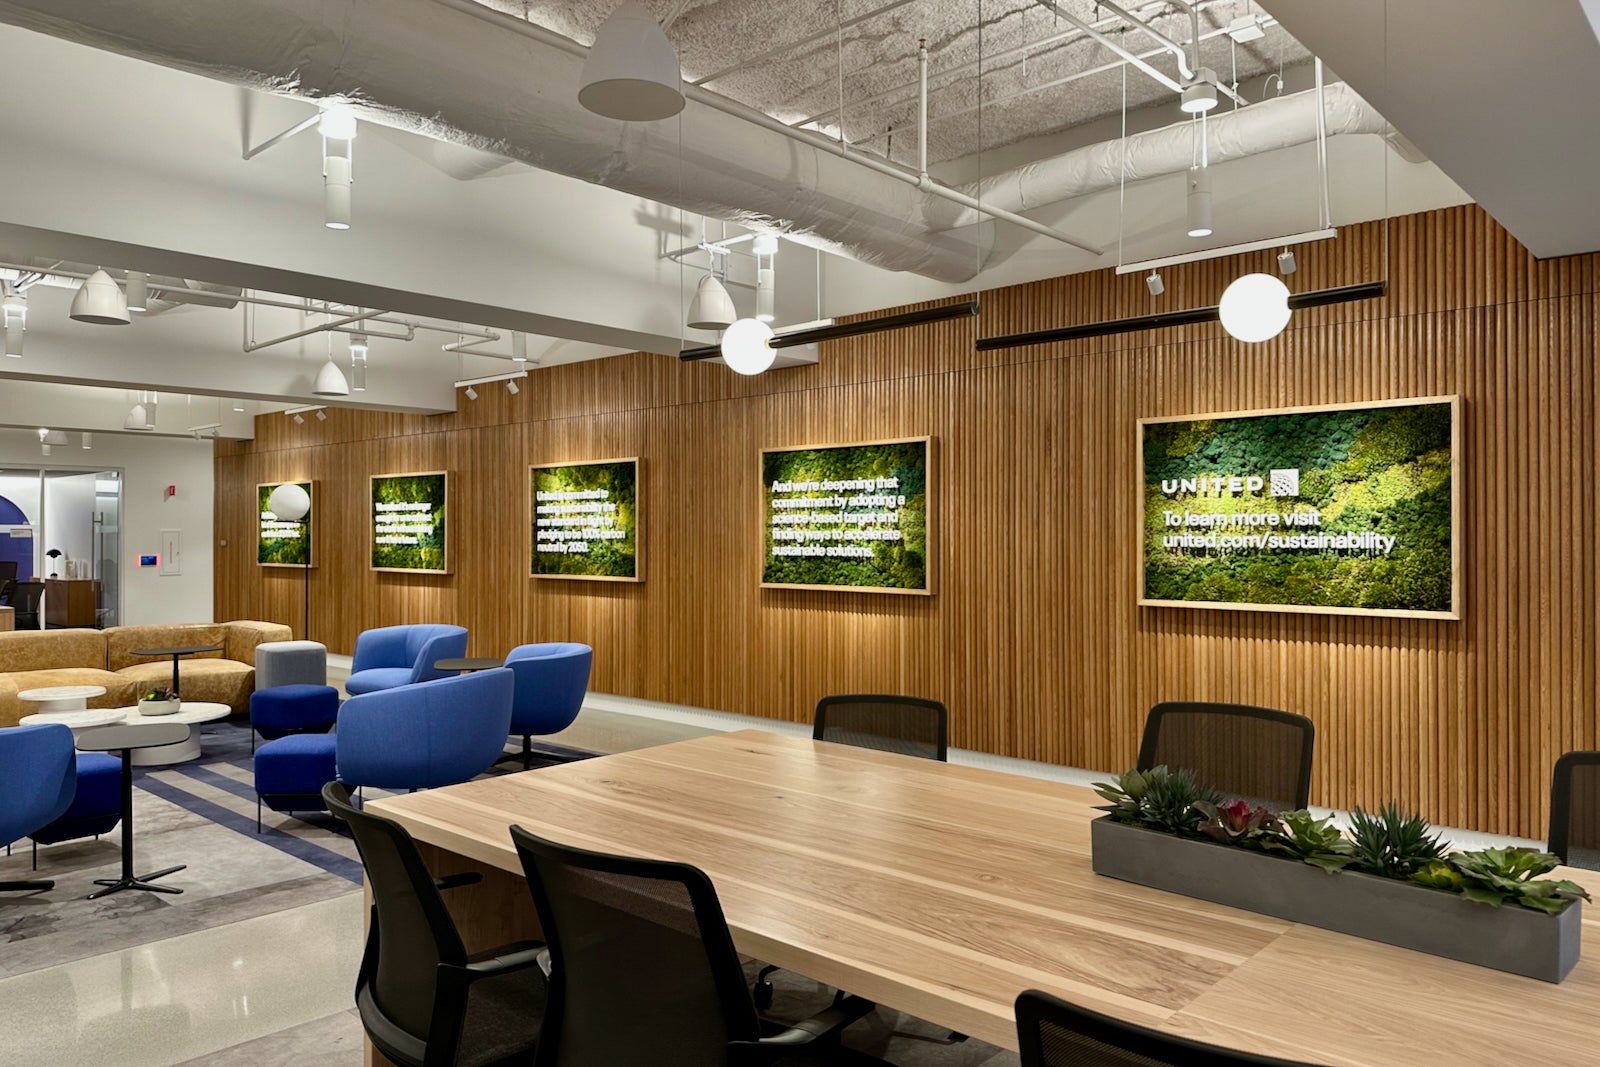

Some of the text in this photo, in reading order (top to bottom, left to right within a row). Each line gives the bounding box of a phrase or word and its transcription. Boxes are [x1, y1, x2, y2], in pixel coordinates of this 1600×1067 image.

[772, 476, 898, 492] And we're deepening that
[1162, 477, 1263, 494] UNITED
[772, 494, 905, 508] commitment by adopting a
[772, 510, 898, 525] science-based target and
[1163, 510, 1321, 527] To learn more visit
[773, 528, 900, 542] finding ways to accelerate
[1163, 531, 1396, 553] united.com/sustainability
[772, 544, 874, 557] sustainable solutions.
